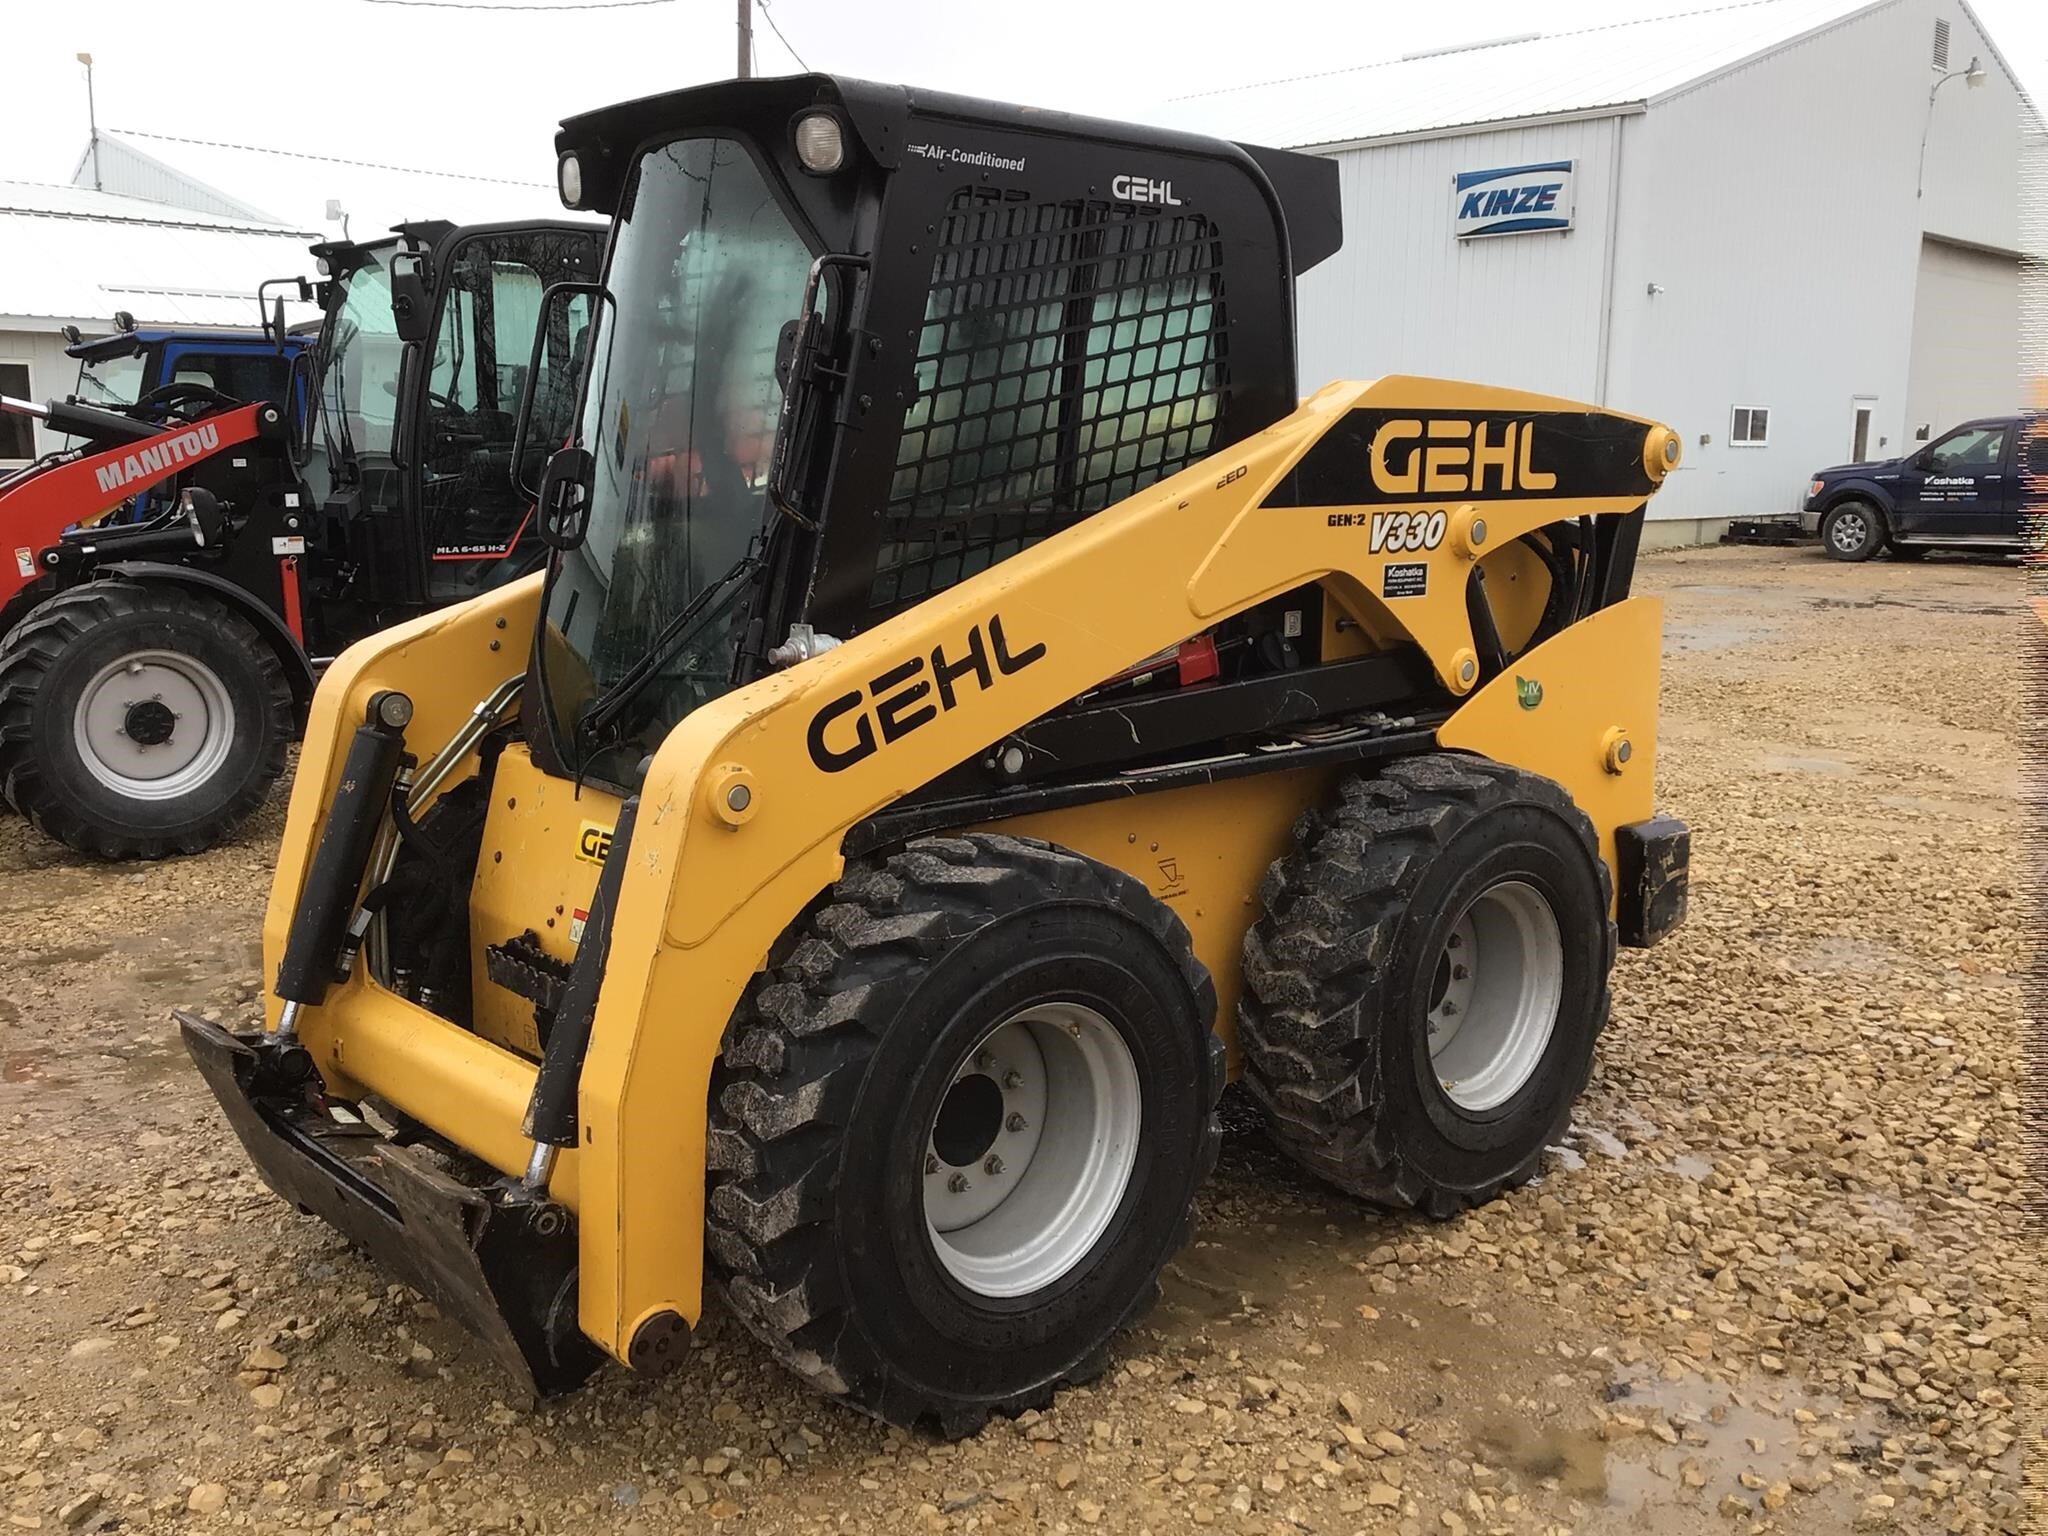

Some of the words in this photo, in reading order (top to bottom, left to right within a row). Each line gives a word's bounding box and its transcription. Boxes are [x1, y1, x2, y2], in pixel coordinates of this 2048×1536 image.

[927, 145, 1025, 172] Air-Conditioned
[1111, 174, 1182, 206] GEHL
[1458, 183, 1563, 219] KINZE
[95, 423, 219, 494] MANITOU
[1370, 419, 1558, 495] GEHL
[1924, 475, 1975, 485] Koshatka
[1327, 513, 1366, 527] GEN:2
[1368, 509, 1449, 555] V330
[436, 546, 460, 554] MLA
[806, 613, 1047, 773] GEHL
[580, 827, 614, 861] GE
